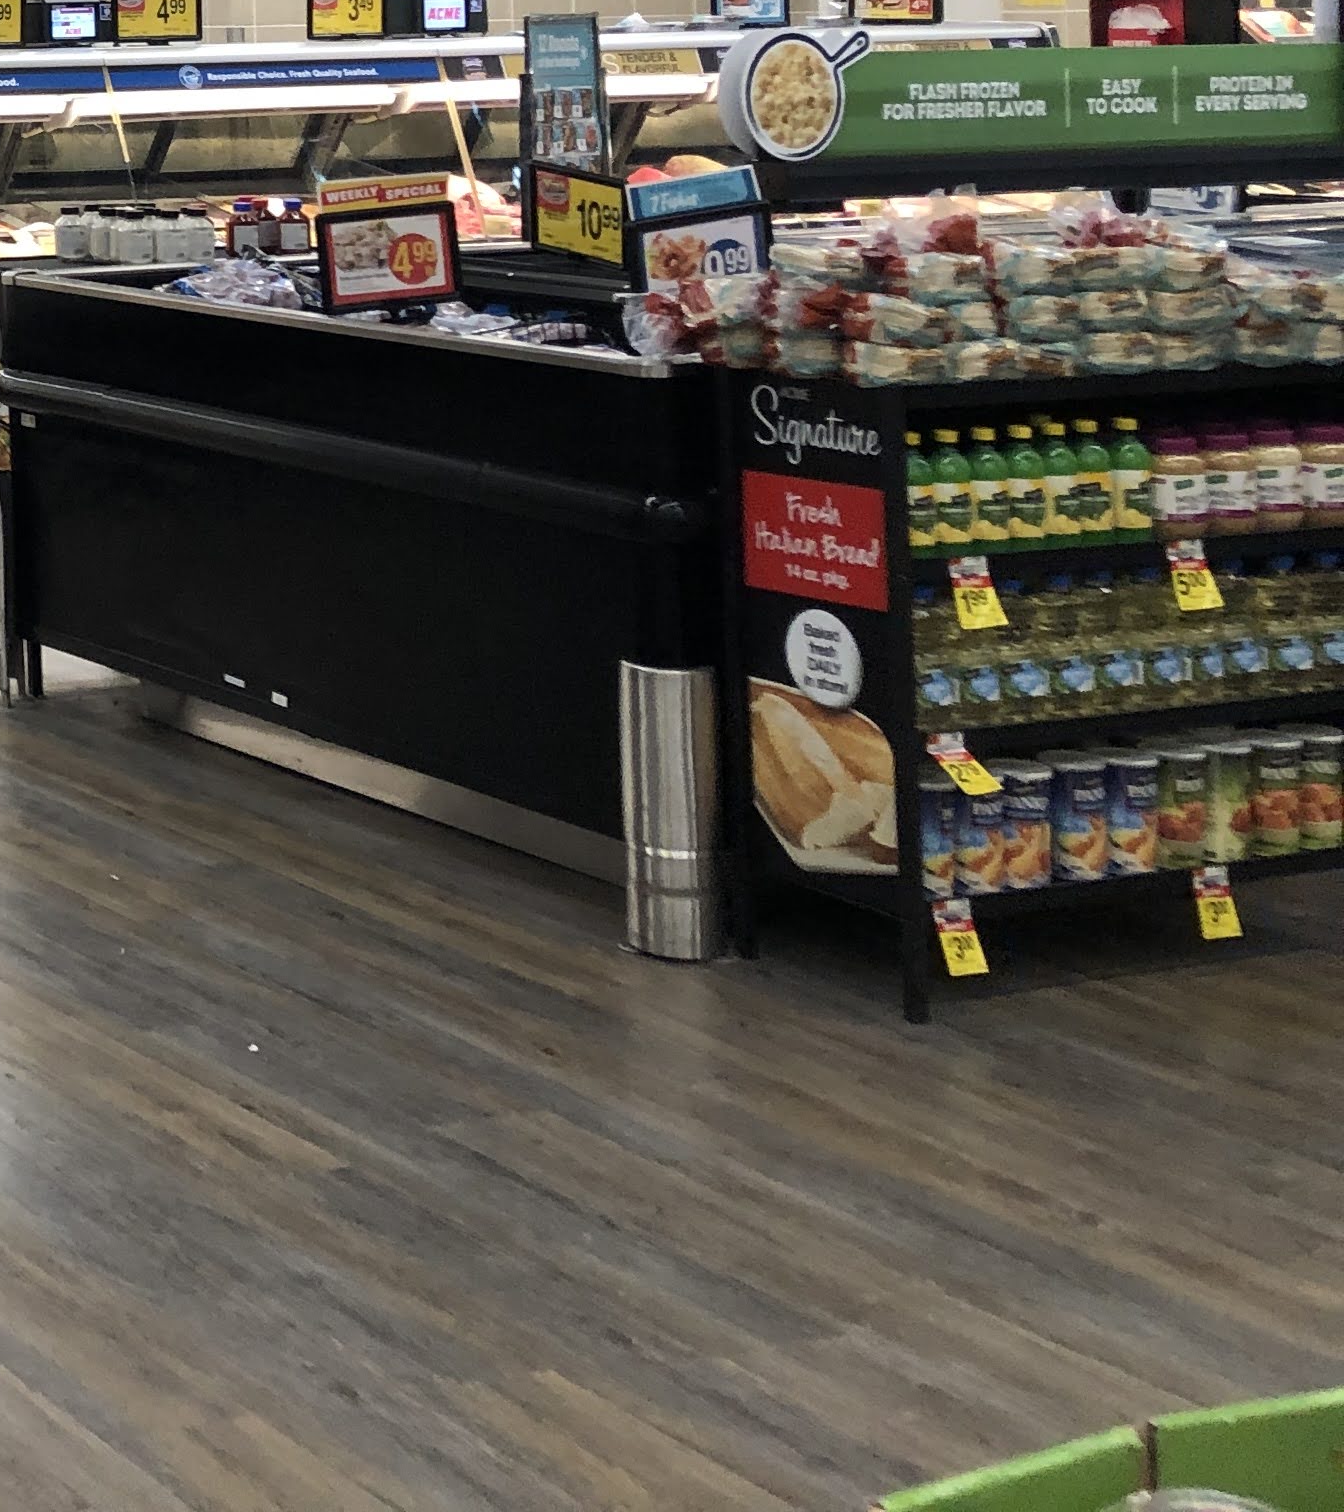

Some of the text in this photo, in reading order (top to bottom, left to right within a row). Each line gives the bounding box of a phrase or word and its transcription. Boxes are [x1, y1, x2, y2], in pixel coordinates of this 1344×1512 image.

[428, 8, 462, 21] ACME
[621, 52, 665, 64] TENDER
[290, 69, 310, 78] Fresh
[909, 82, 1020, 100] FLASH FROZEN
[1102, 79, 1141, 96] EASY
[1210, 76, 1293, 92] PROTEIN IN
[882, 99, 1047, 120] FOR FRESHER FLAVOR
[1087, 97, 1158, 115] TO COOK
[1196, 93, 1308, 112] EVERY SERVING
[327, 184, 442, 203] WEEKLY SPECIAL
[750, 384, 882, 465] Signature
[784, 490, 842, 527] Fresh
[821, 534, 879, 568] Bread
